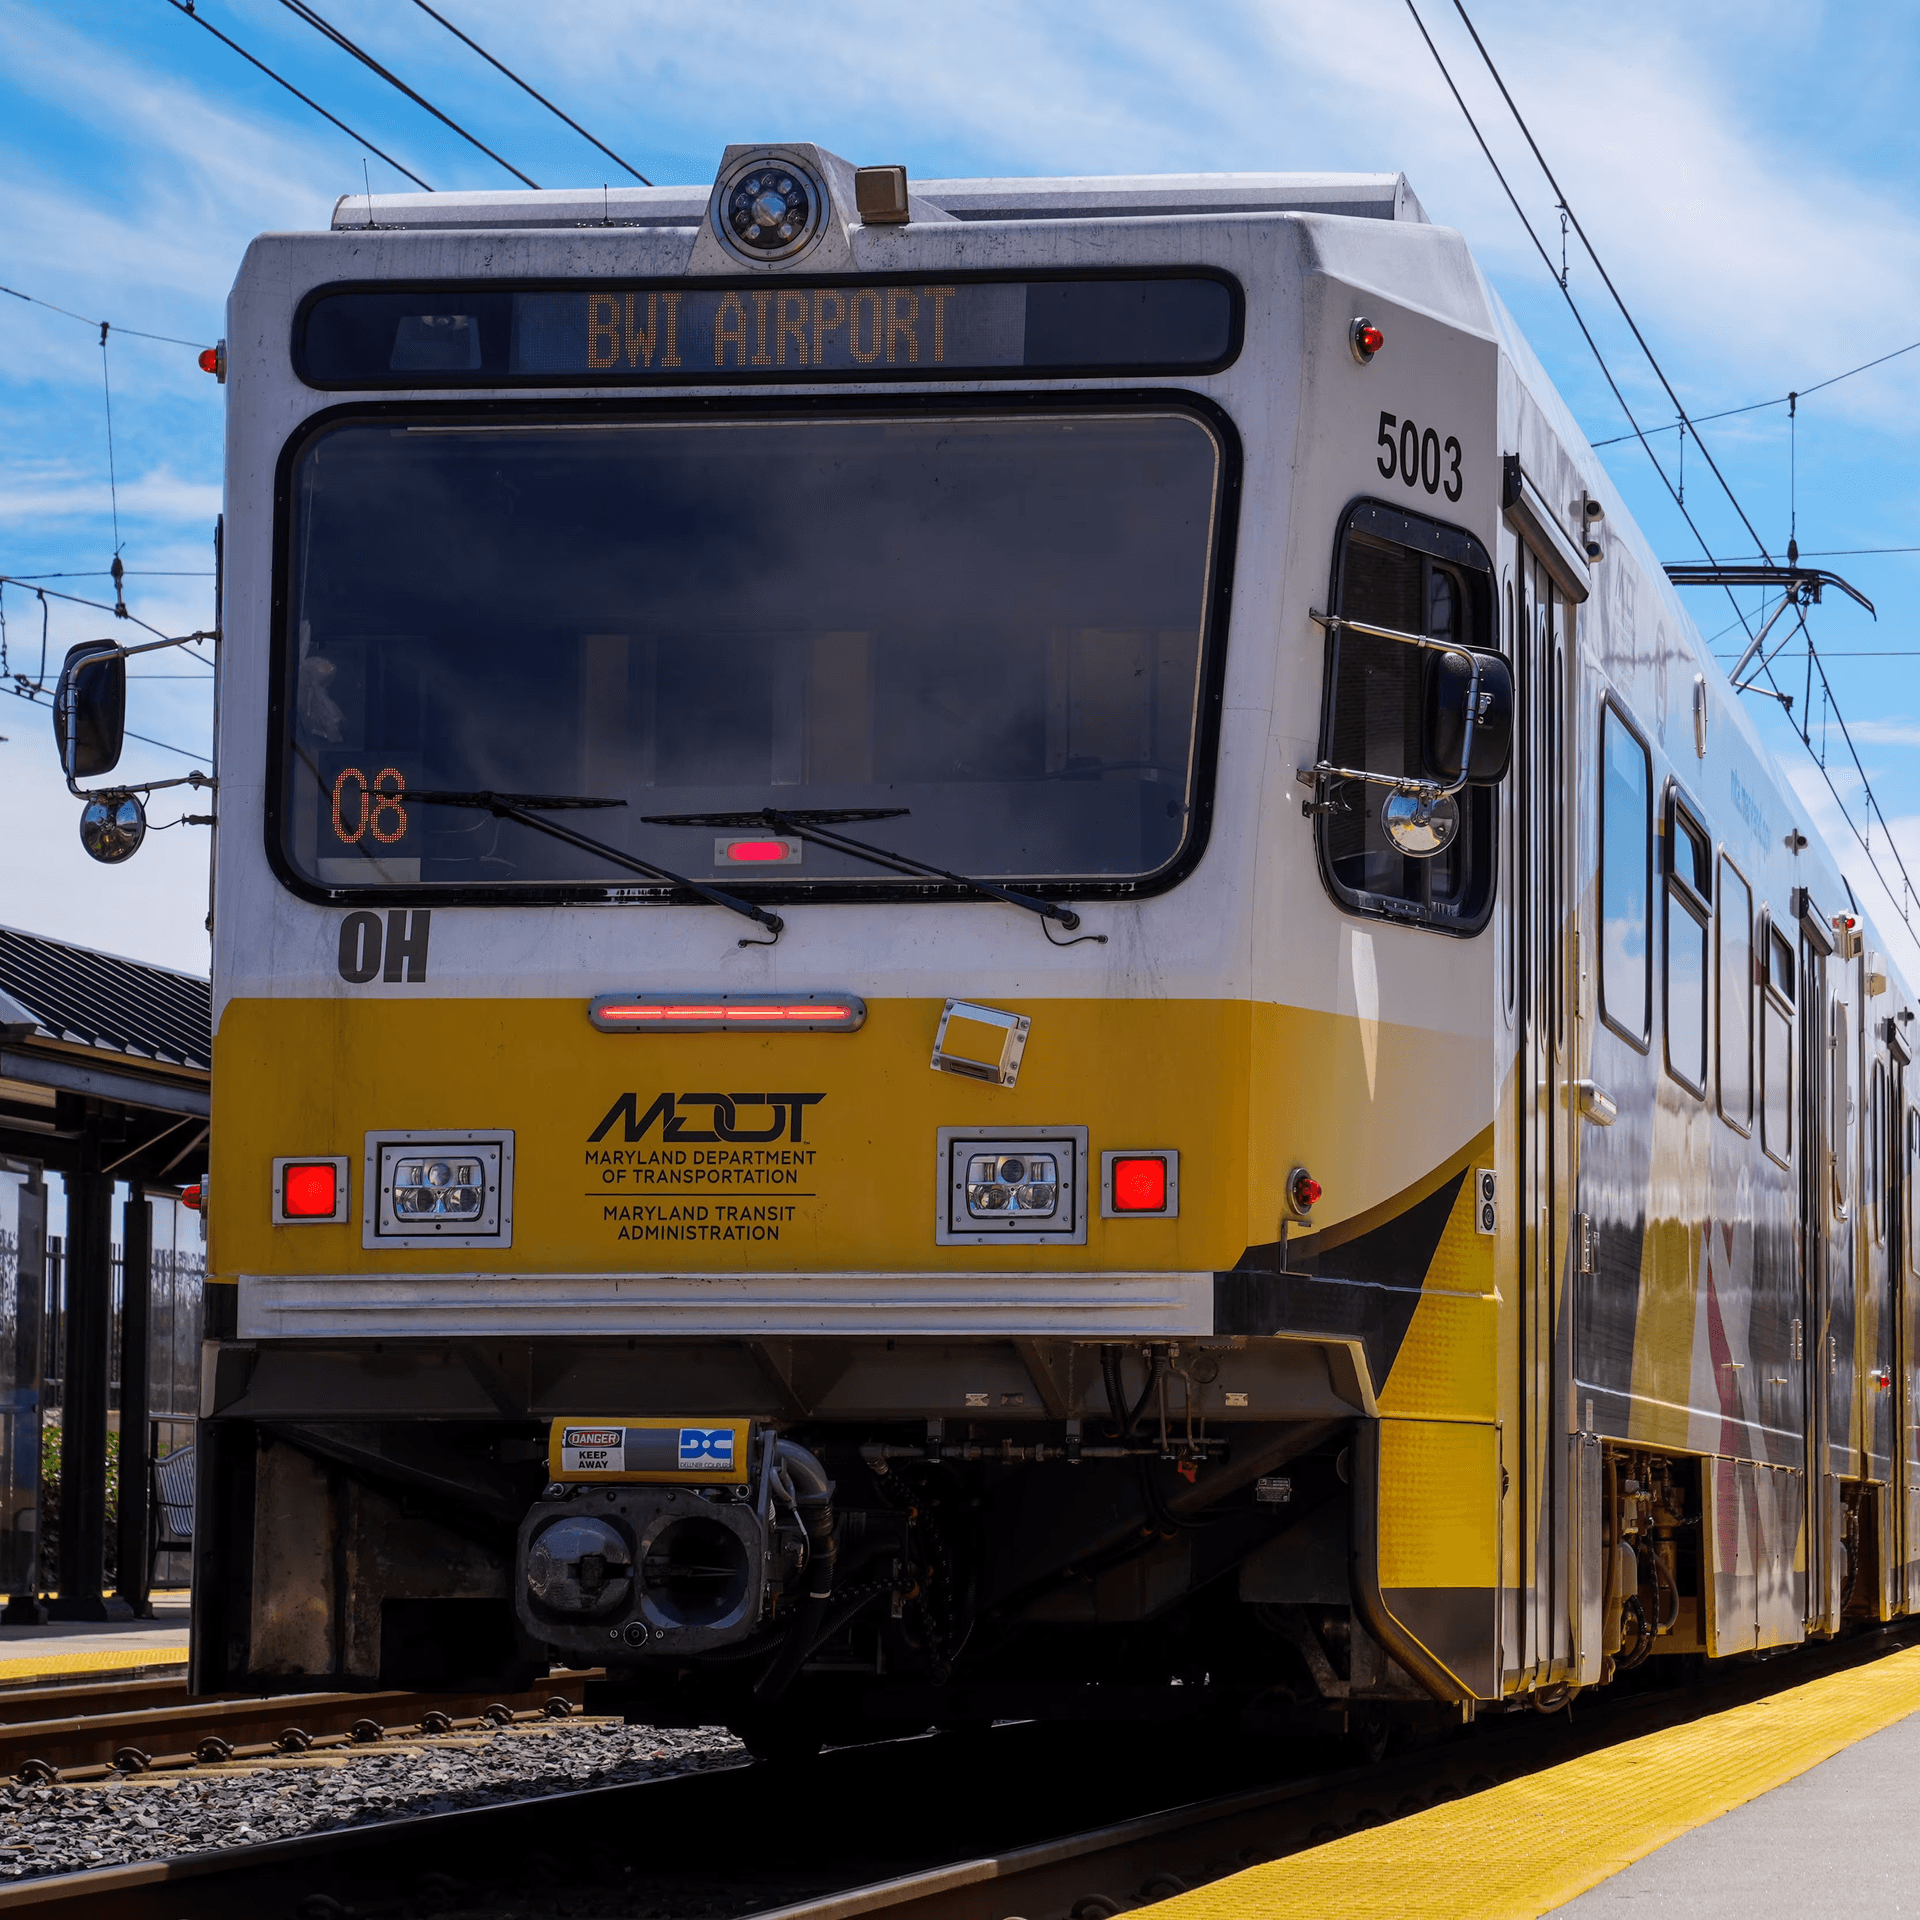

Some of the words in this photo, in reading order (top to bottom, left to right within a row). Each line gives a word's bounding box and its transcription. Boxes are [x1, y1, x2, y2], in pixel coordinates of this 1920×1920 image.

[587, 293, 682, 368] BWI
[714, 287, 956, 366] AIRPORT
[1376, 410, 1463, 503] 5003
[332, 767, 408, 843] 08
[338, 909, 431, 984] OH
[586, 1092, 828, 1143] MDOT
[585, 1150, 687, 1165] MARYLAND
[693, 1150, 817, 1165] DEPARTMENT
[602, 1169, 627, 1184] OF
[633, 1169, 798, 1184] TRANSPORTATION
[603, 1206, 709, 1221] MARYLAND
[715, 1206, 796, 1221] TRANSIT
[617, 1225, 780, 1241] ADMINISTRATION
[571, 1433, 617, 1444] DANGER
[579, 1450, 608, 1459] KEEP
[578, 1460, 609, 1469] AWAY
